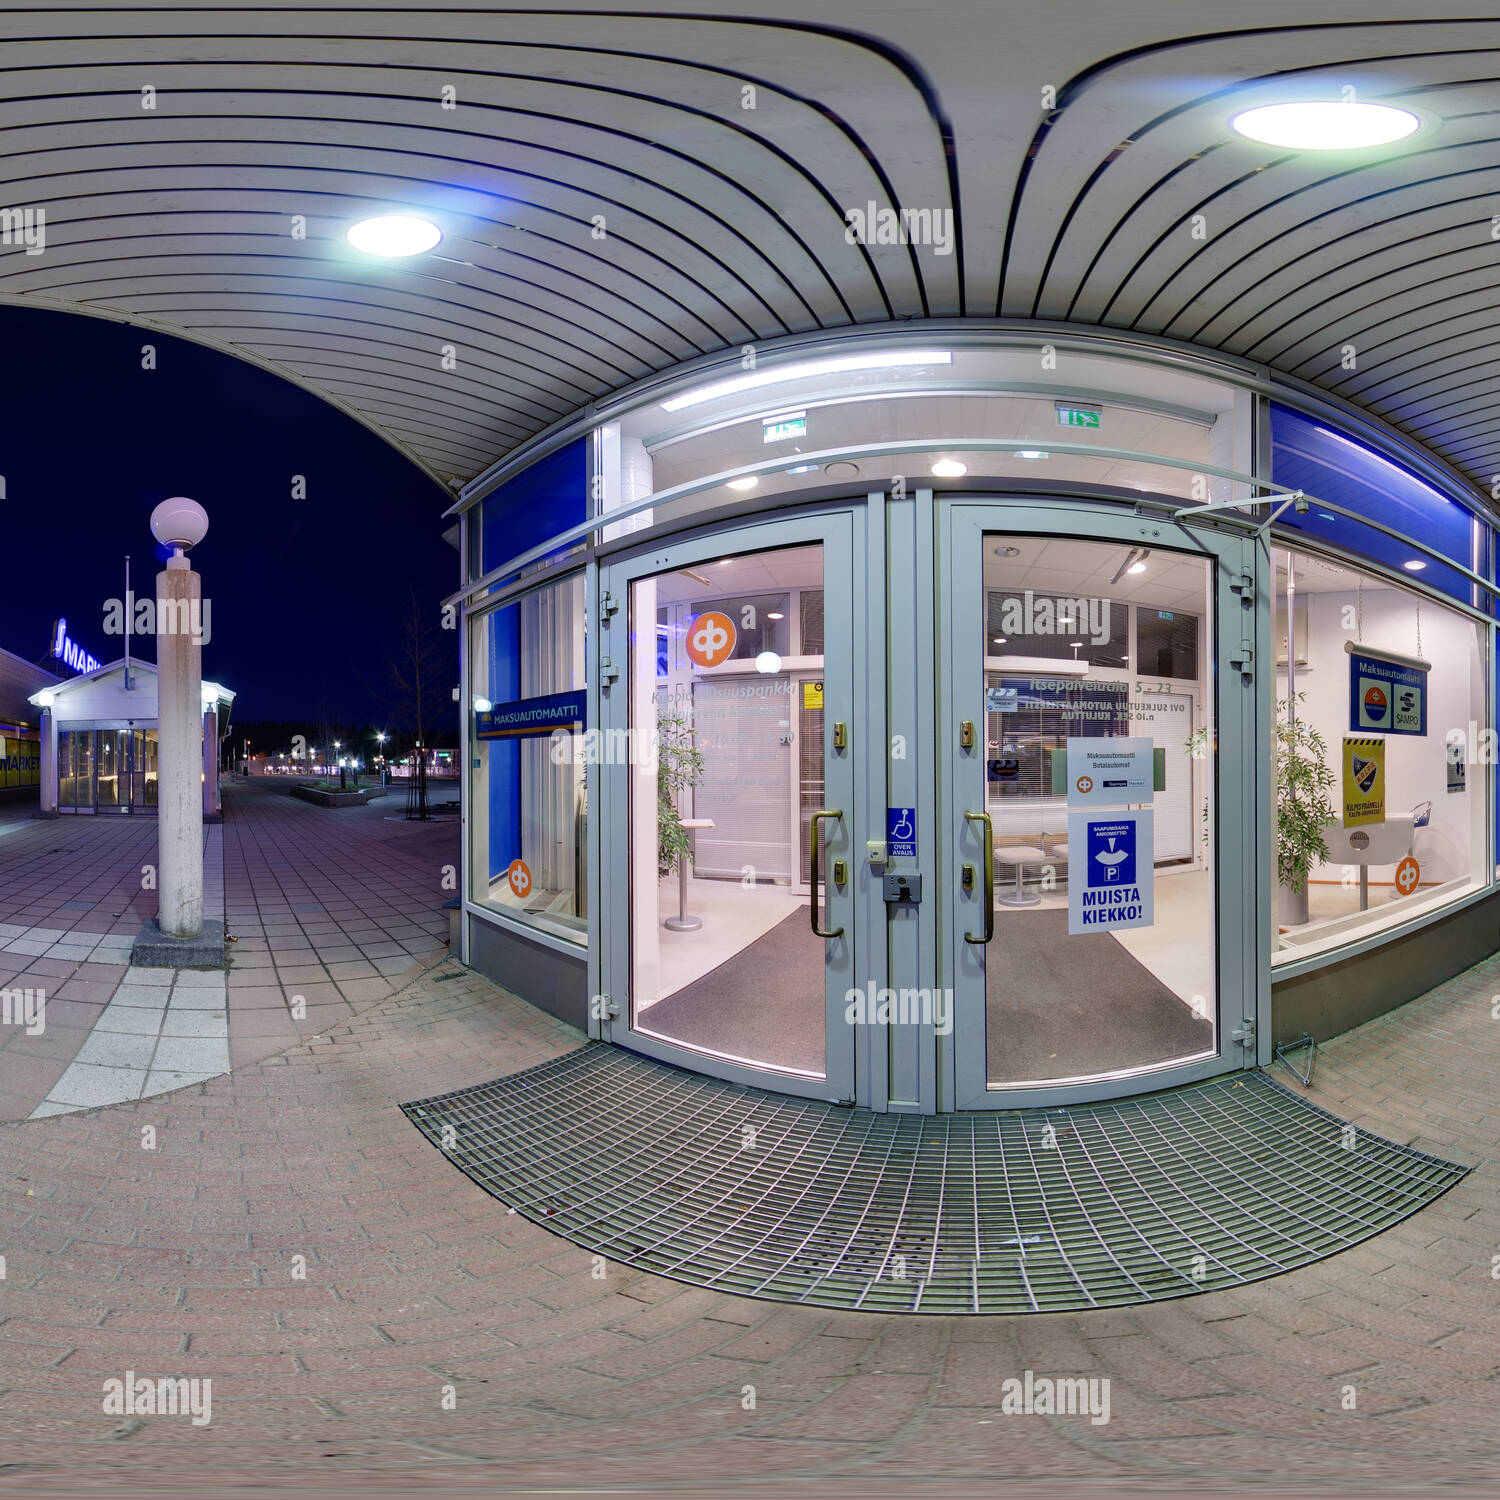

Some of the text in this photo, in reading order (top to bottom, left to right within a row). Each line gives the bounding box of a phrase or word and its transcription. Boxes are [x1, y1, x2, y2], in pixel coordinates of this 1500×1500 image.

[1029, 678, 1128, 694] Itsepalvelutila
[1136, 682, 1142, 693] 5
[1158, 683, 1172, 694] 23
[494, 705, 578, 725] MAKSUAUTOMAATTI
[1396, 714, 1418, 725] SAMPO
[1087, 752, 1136, 760] Maksuautomaatti
[1107, 868, 1116, 880] P
[1082, 888, 1140, 906] MUISTA
[1083, 906, 1142, 924] KIEKKO!
